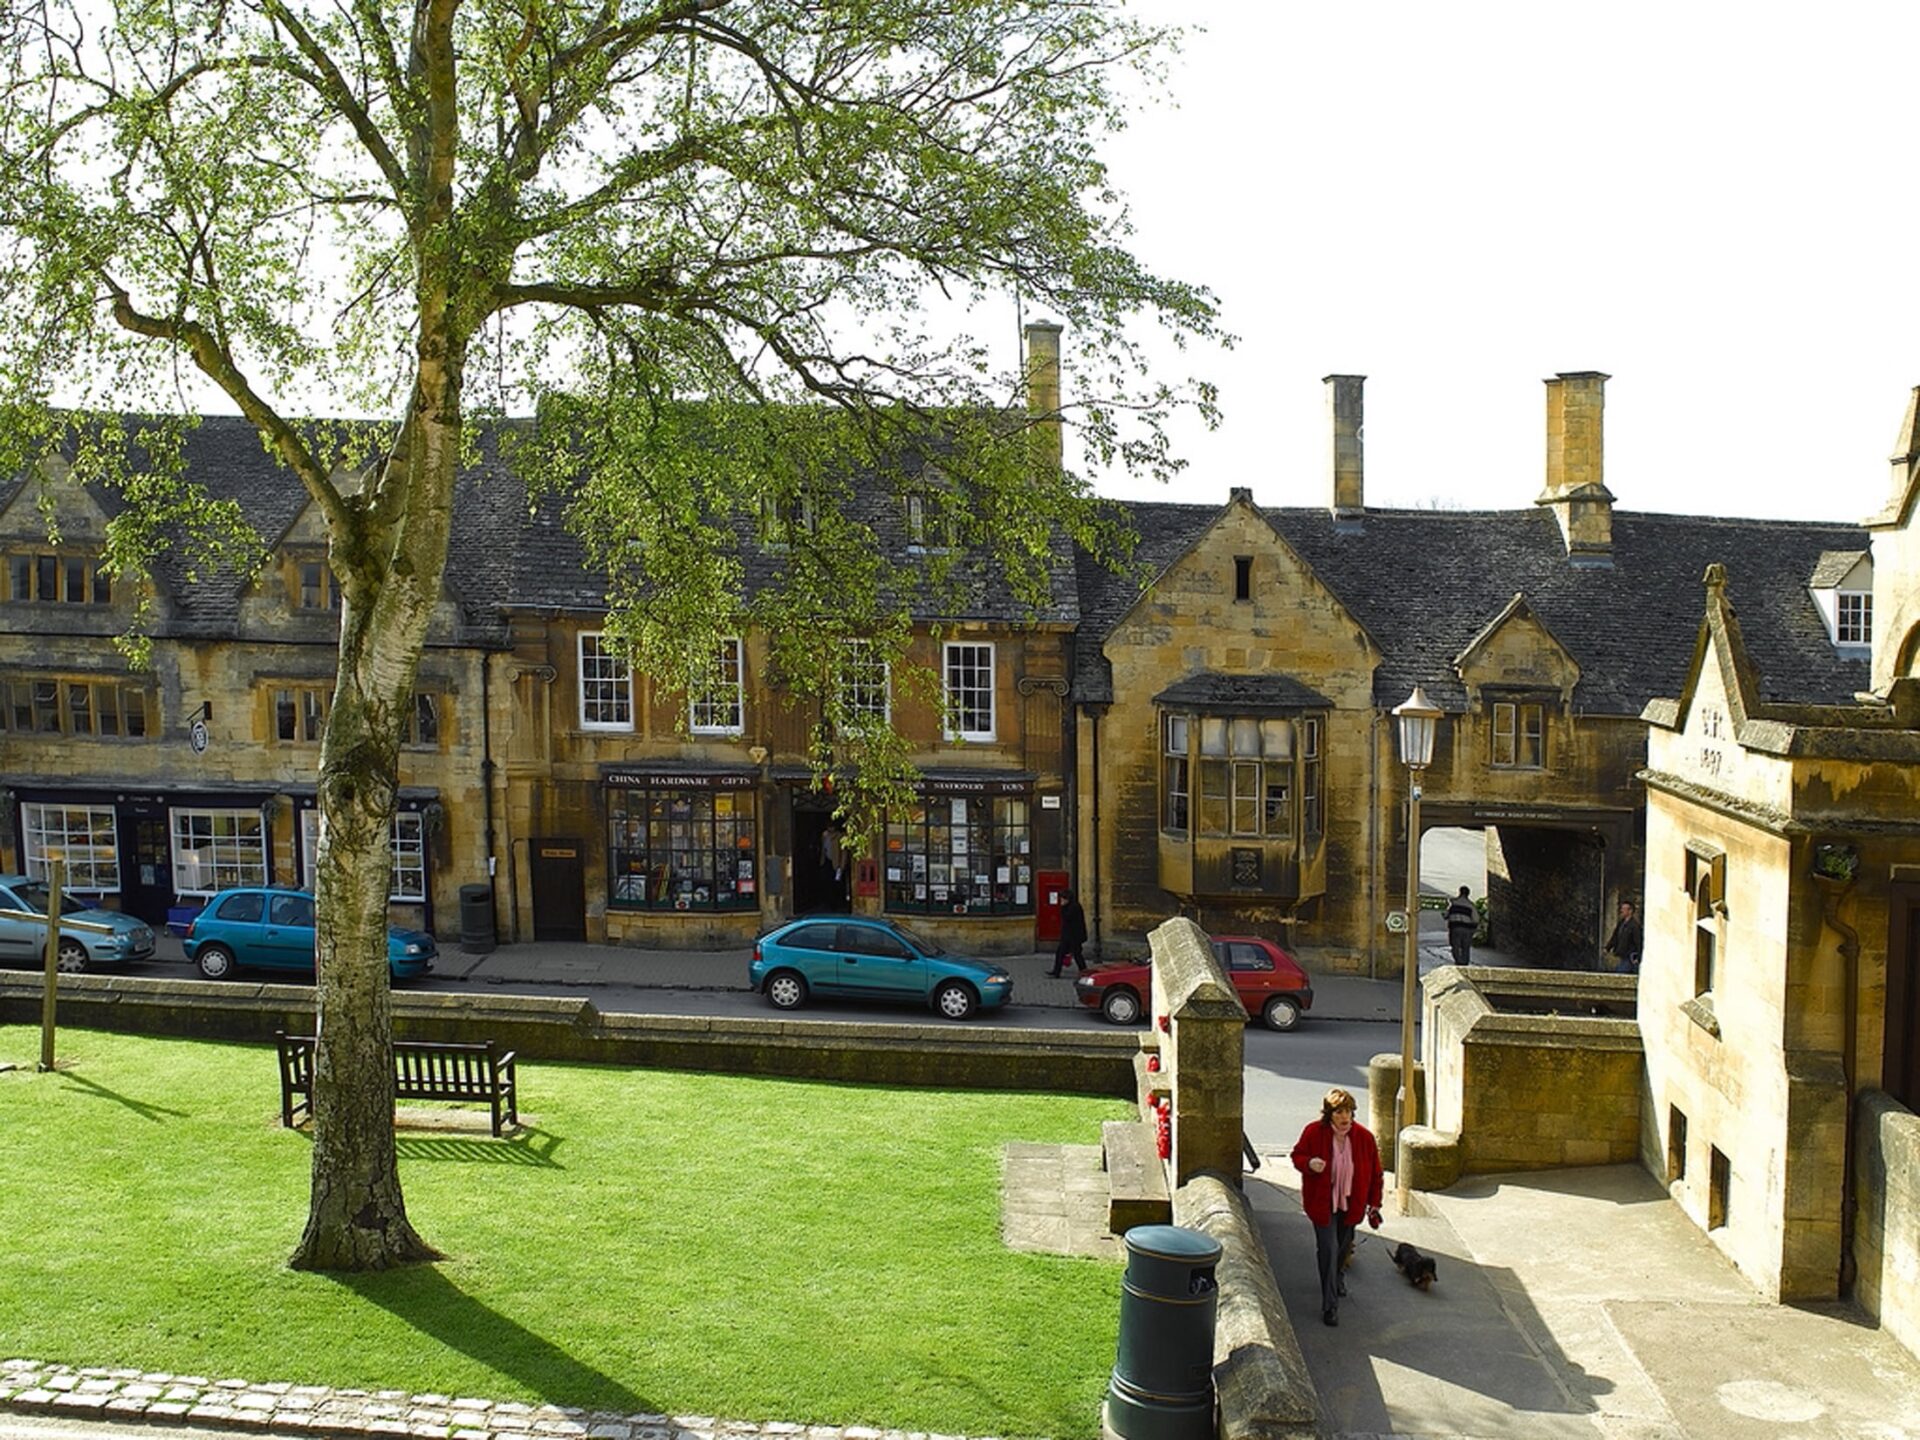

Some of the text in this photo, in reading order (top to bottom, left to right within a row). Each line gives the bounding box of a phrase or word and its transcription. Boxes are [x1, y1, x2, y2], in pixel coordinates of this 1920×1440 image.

[608, 774, 751, 786] CHINA HARDWARE GIFTS
[934, 782, 985, 790] STATIONERY
[1002, 783, 1025, 791] TOYS
